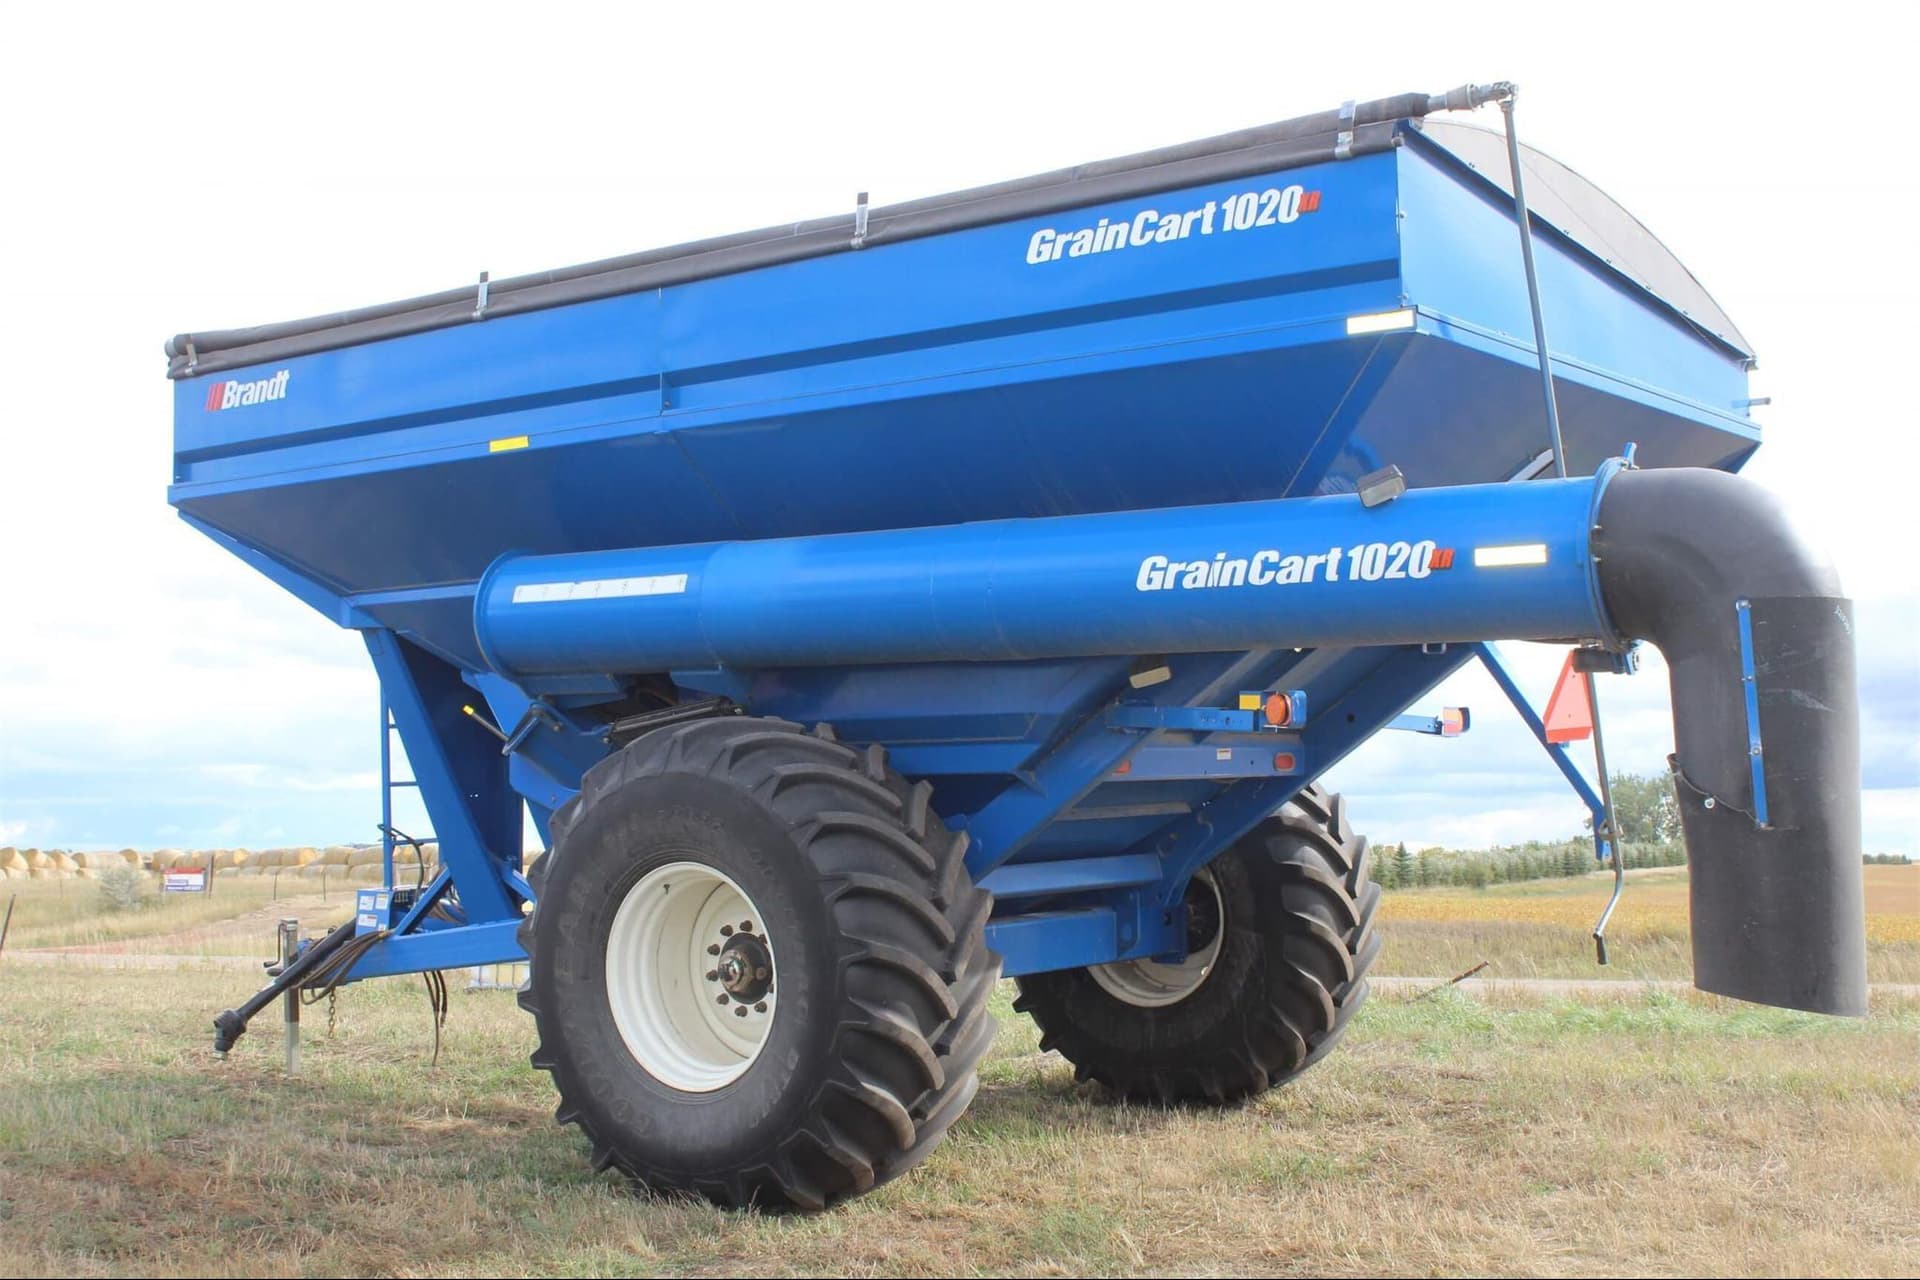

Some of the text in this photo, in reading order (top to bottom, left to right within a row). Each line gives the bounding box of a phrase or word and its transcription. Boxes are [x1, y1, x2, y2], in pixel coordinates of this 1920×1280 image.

[1026, 201, 1216, 265] GrainCart
[221, 369, 290, 410] Brandt
[1136, 546, 1342, 592] GrainCart
